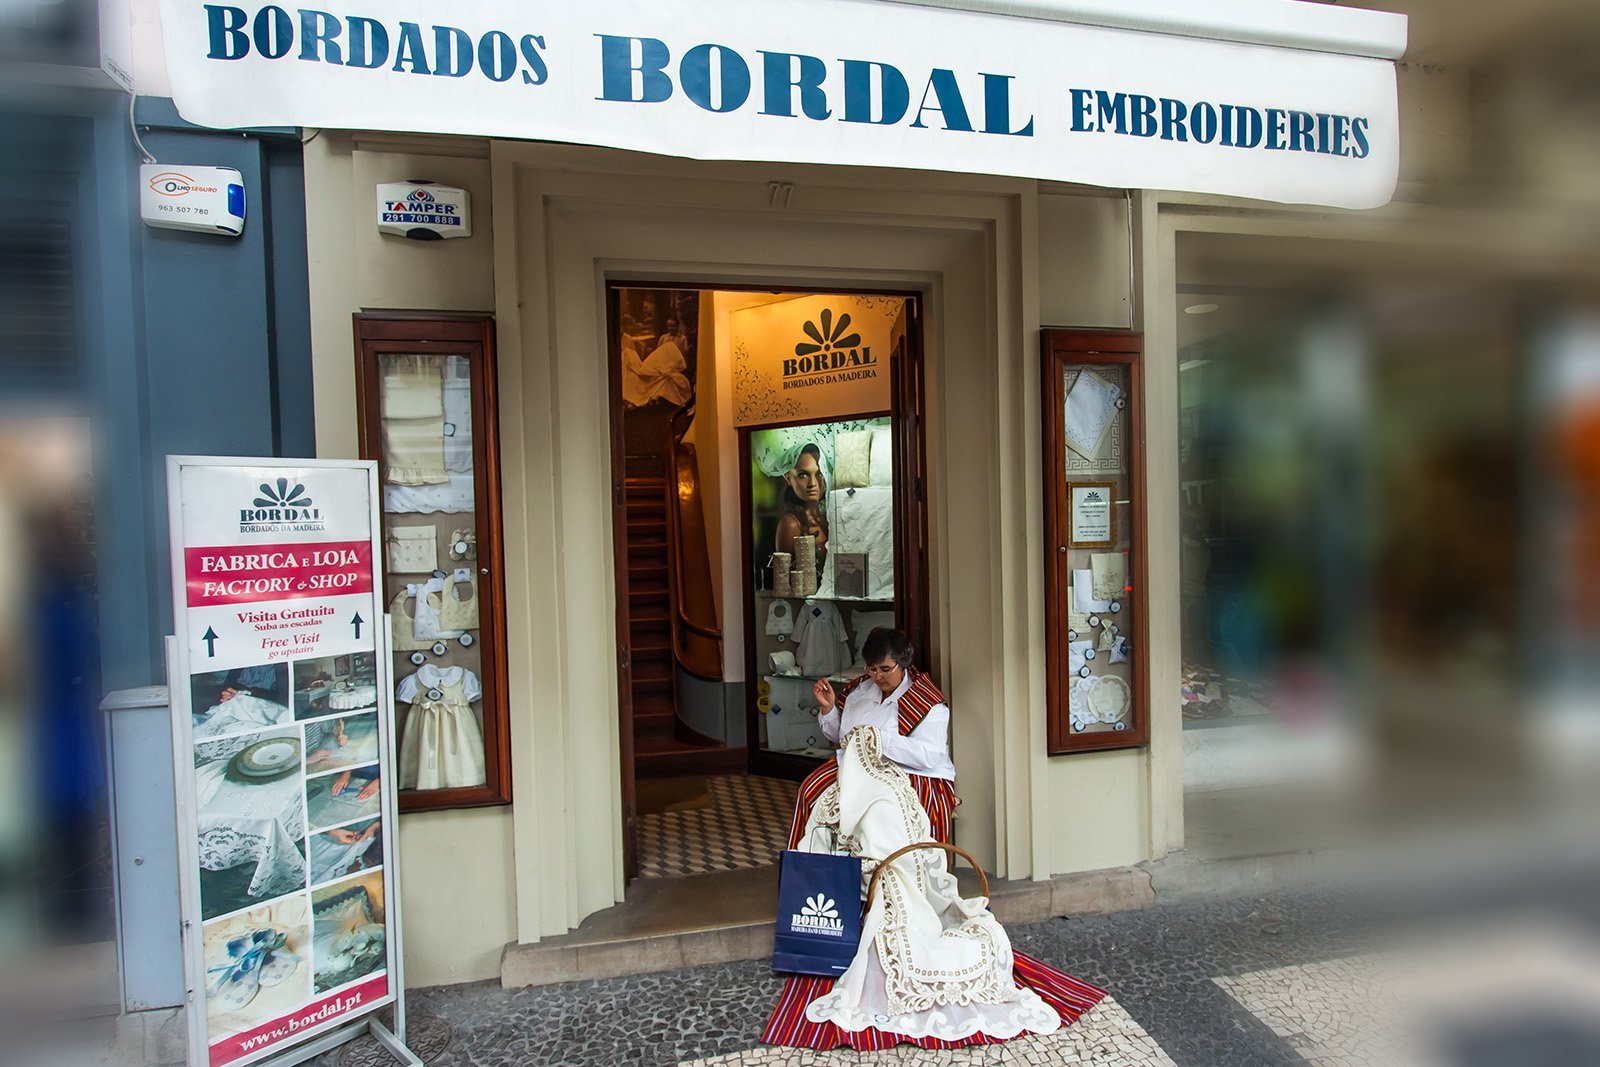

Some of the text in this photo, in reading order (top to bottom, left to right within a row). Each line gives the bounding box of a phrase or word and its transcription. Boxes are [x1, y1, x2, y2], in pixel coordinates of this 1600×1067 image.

[205, 4, 1369, 159] BORDADOS BORDAL EMBROIDERIES
[768, 180, 794, 208] 77
[158, 204, 173, 212] 963
[385, 202, 455, 215] TAMPER
[385, 213, 454, 225] 291 700 888
[783, 347, 877, 376] BORDAL
[783, 369, 877, 389] BORDADOS DA MADEIRA
[240, 508, 324, 522] BORDAL
[240, 525, 280, 534] BORDADOS
[293, 524, 325, 532] MADEIRA
[201, 549, 360, 573] FABRICA E LOJA
[202, 576, 295, 597] FACTORY
[308, 573, 358, 589] SHOP
[237, 605, 335, 624] Visita Gratuita
[254, 622, 277, 631] Suba
[290, 618, 322, 628] escadas
[261, 632, 320, 649] Free Visit
[268, 645, 314, 660] go upstairs
[792, 914, 844, 929] BORDAL
[240, 991, 362, 1052] www.bordal.pt
